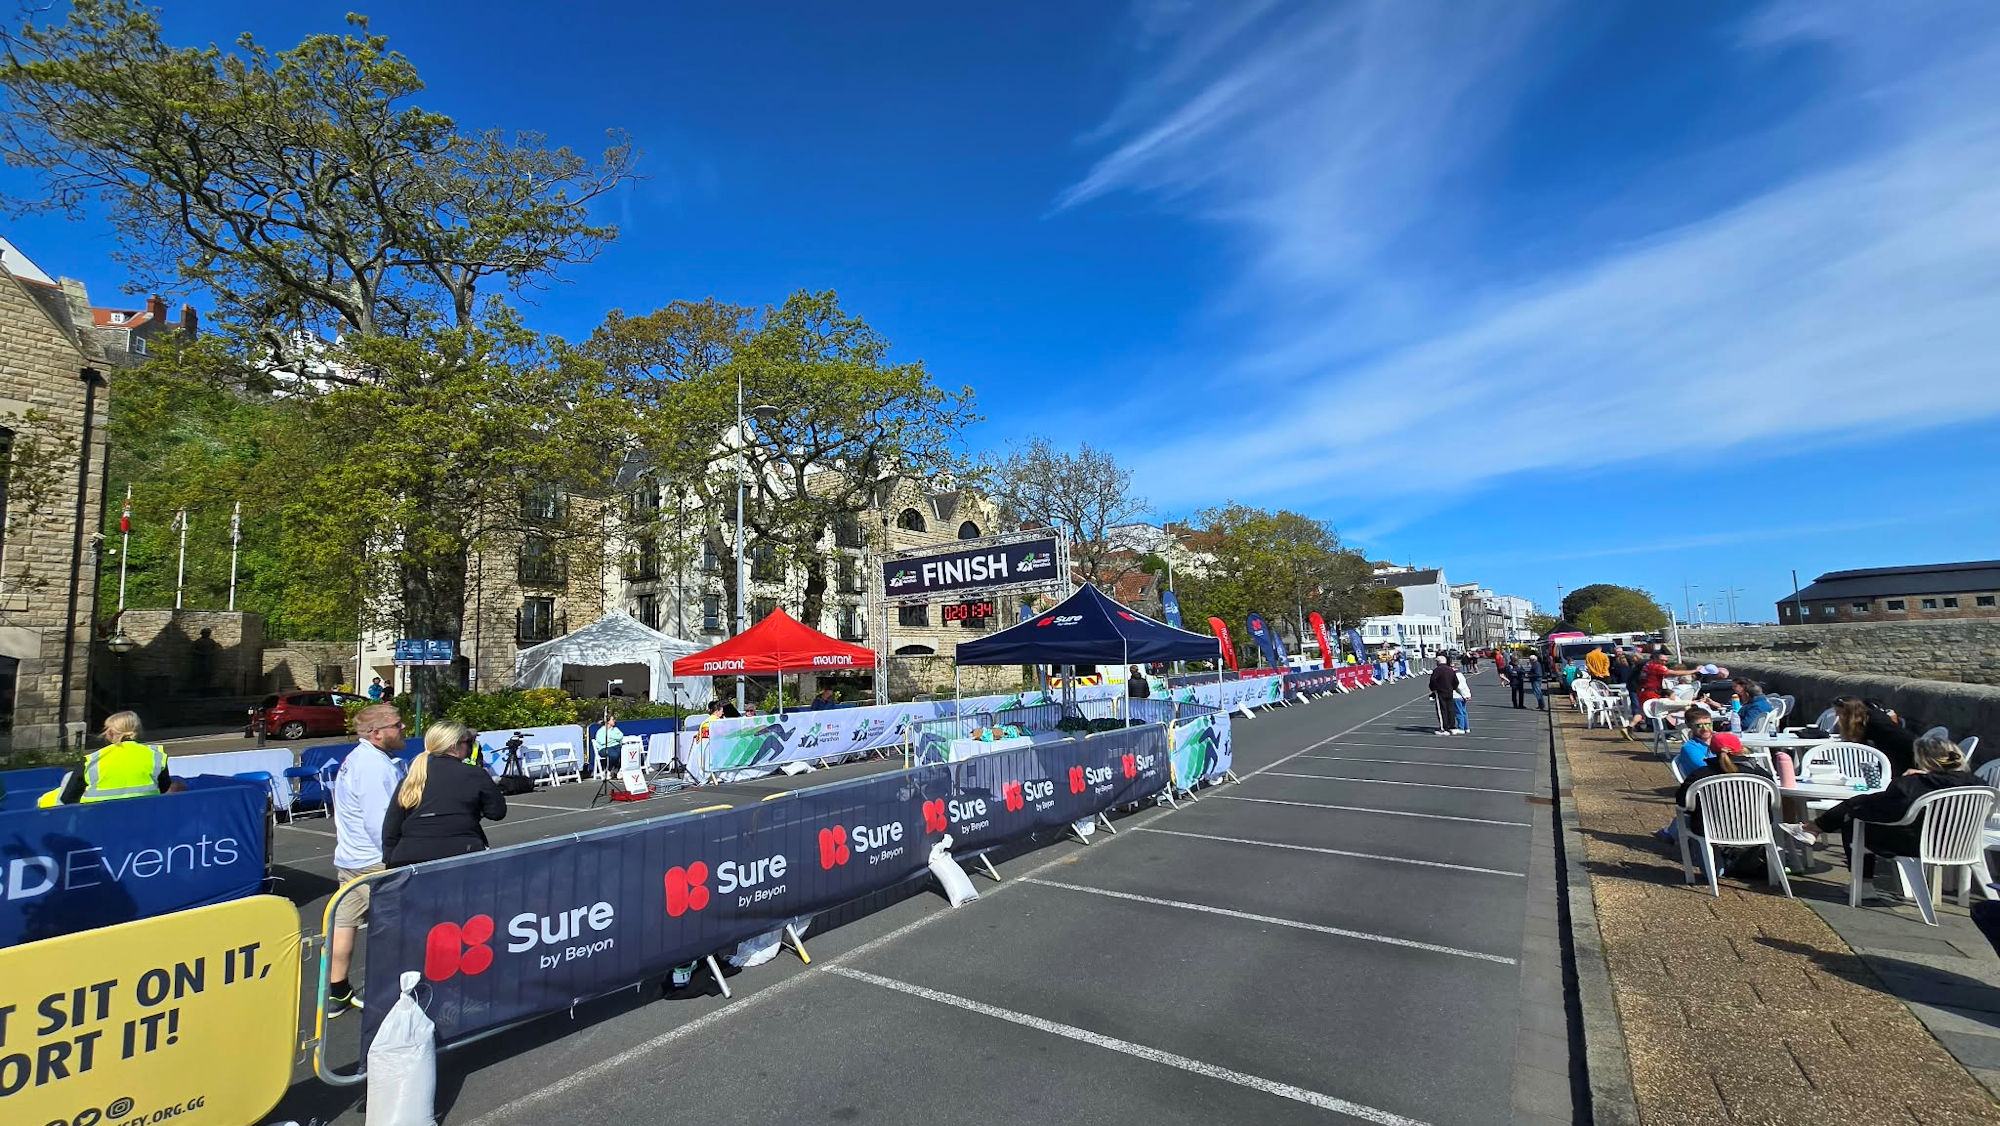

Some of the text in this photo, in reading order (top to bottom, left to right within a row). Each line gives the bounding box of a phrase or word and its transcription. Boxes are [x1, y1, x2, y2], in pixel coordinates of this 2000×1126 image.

[922, 552, 1009, 587] FINISH
[944, 602, 993, 620] 02:01:34
[1053, 614, 1083, 623] Sure
[703, 658, 745, 671] mourant
[813, 654, 853, 666] mourant
[1136, 754, 1154, 771] Sure
[1085, 765, 1113, 785] Sure
[1024, 780, 1054, 801] Sure
[948, 798, 987, 823] Sure
[852, 821, 904, 853] Sure
[961, 819, 989, 835] by Beyon
[869, 846, 904, 865] by Beyon
[717, 854, 787, 894] Sure
[738, 884, 786, 908] by Beyon
[507, 901, 615, 953] Sure
[540, 938, 614, 969] by Beyon
[37, 978, 118, 1036] SIT
[136, 956, 206, 1007] ON
[224, 941, 273, 985] IT,
[0, 1007, 180, 1097] ORT IT!
